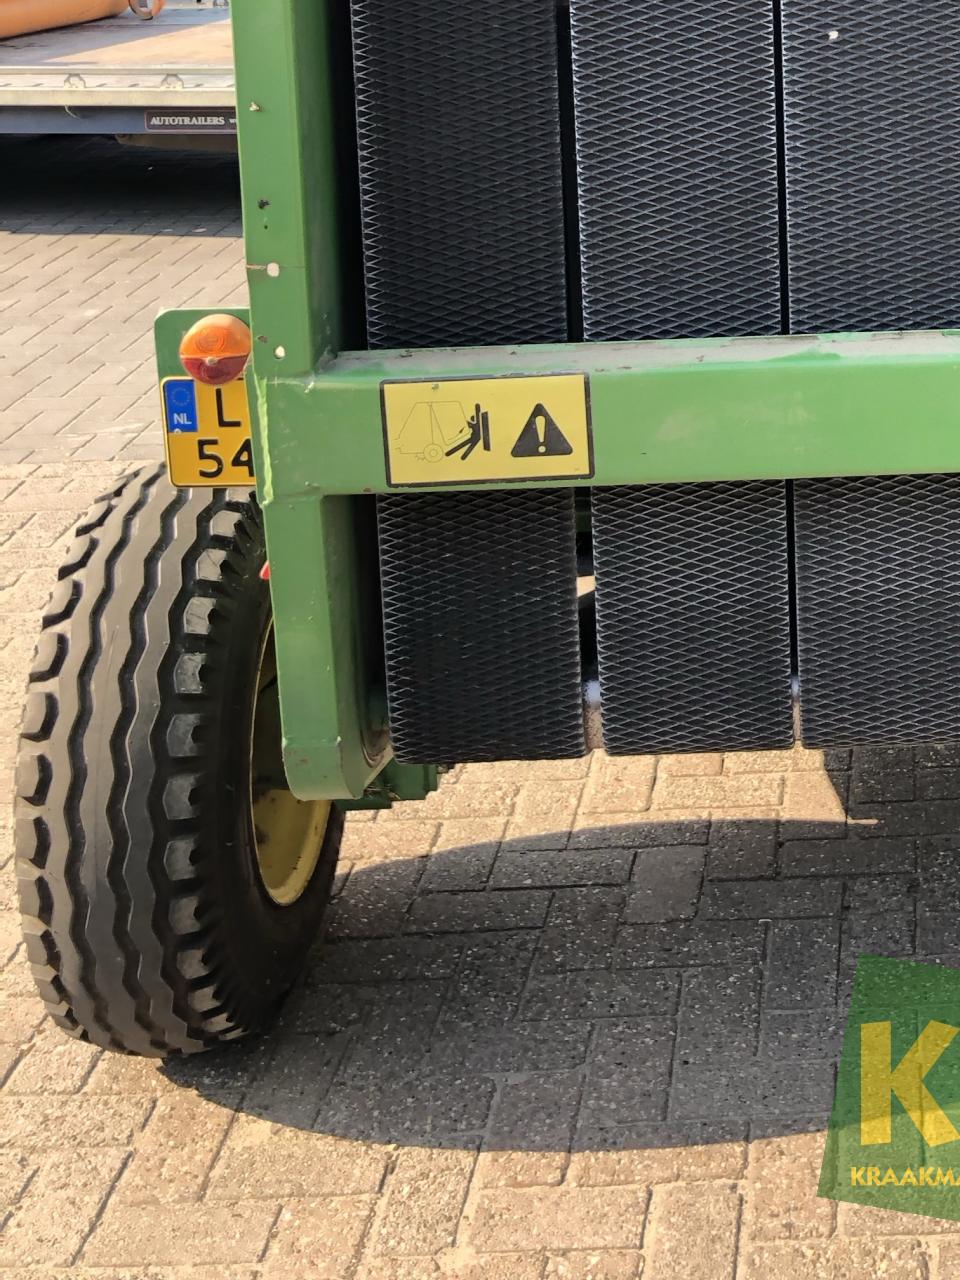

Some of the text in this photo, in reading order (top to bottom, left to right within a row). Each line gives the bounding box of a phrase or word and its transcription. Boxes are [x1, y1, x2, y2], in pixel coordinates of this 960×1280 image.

[150, 116, 226, 126] AUTOTRAILERS
[215, 387, 242, 428] L
[173, 412, 192, 425] NL
